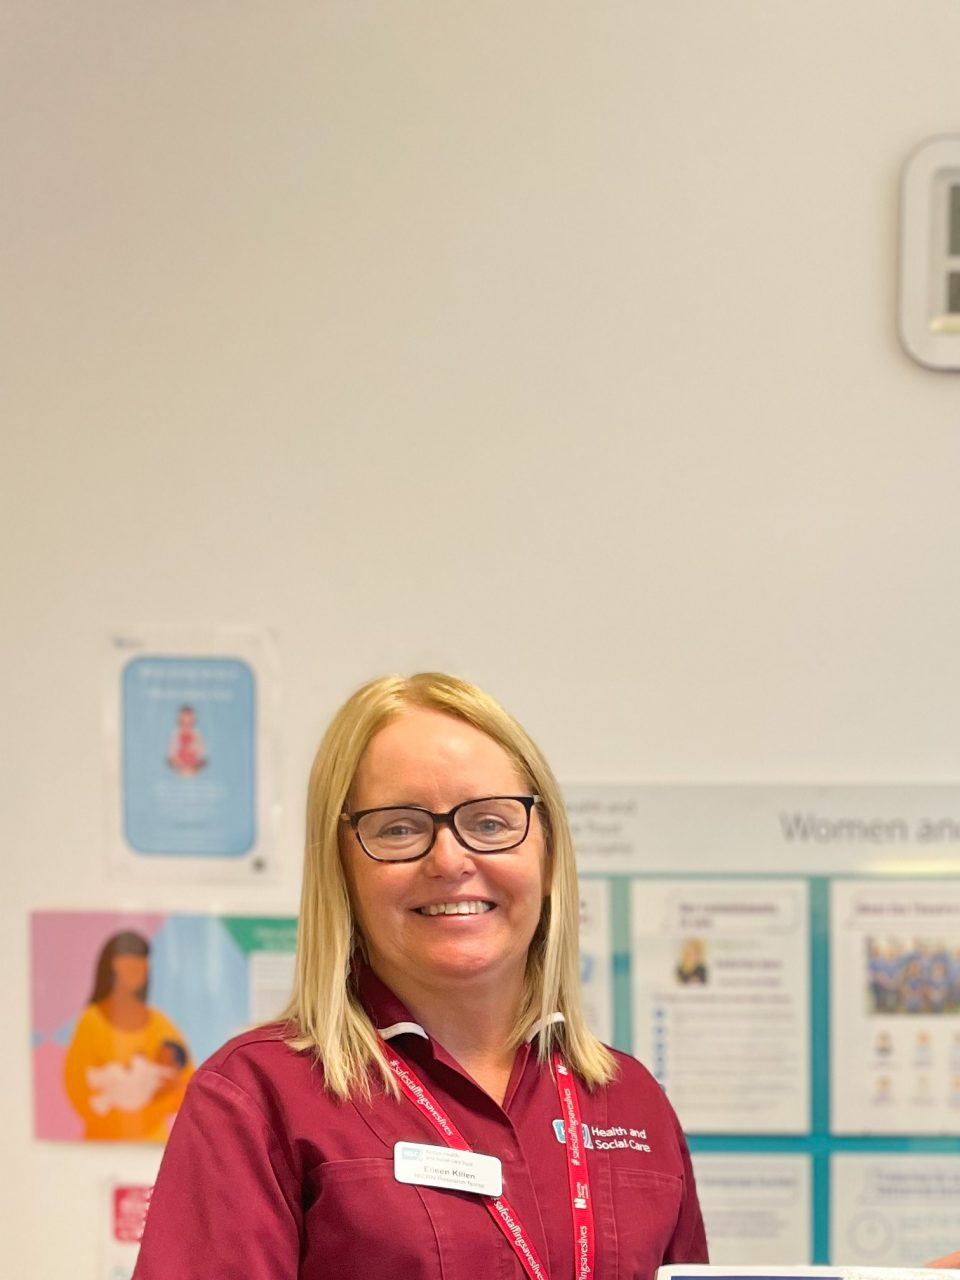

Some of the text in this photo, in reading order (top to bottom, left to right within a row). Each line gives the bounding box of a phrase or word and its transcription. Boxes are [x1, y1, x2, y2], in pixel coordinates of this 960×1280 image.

[780, 812, 908, 843] Women
[592, 1126, 628, 1137] Health
[629, 1127, 647, 1140] and
[595, 1138, 652, 1153] Social Care
[452, 1169, 476, 1180] Killen
